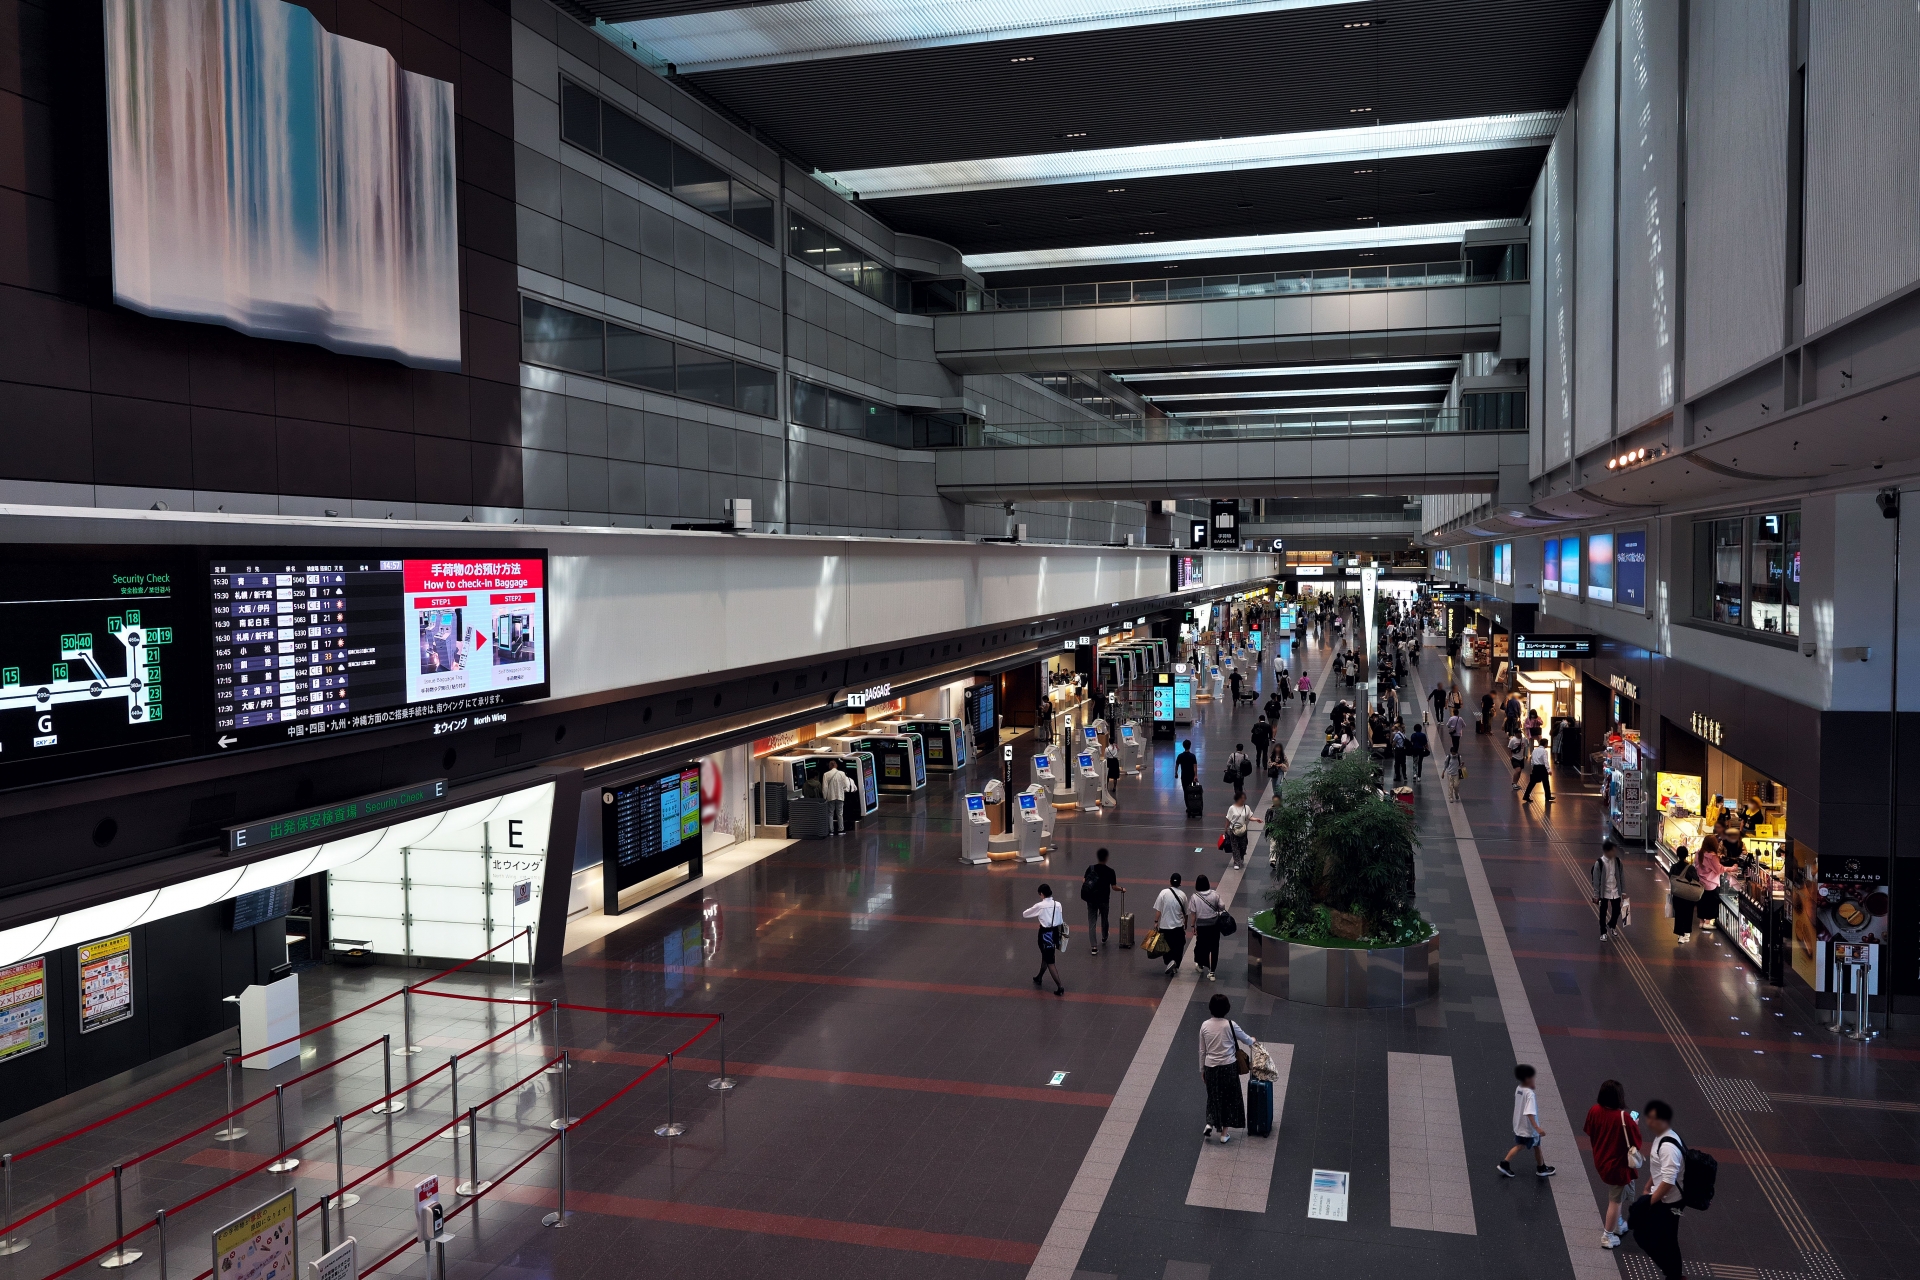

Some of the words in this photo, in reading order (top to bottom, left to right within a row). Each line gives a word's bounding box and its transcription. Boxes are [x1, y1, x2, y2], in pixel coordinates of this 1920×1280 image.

[1194, 526, 1204, 542] F
[1274, 539, 1282, 549] G
[383, 561, 400, 569] 14:57
[431, 564, 521, 577] 手荷物のお預け方法
[113, 574, 144, 585] Security
[147, 574, 170, 582] Check
[424, 580, 444, 589] How
[445, 580, 455, 588] to
[457, 579, 492, 588] check-in
[495, 578, 528, 589] Baggage
[128, 614, 139, 623] 18
[1186, 612, 1191, 621] F
[110, 621, 120, 630] 17
[147, 632, 158, 641] 20
[160, 631, 170, 640] 19
[63, 638, 75, 650] 30
[79, 636, 91, 648] 40
[148, 651, 158, 660] 21
[5, 671, 17, 682] 15
[55, 667, 66, 678] 16
[149, 670, 159, 680] 22
[1610, 674, 1624, 692] AIRPORT
[1626, 681, 1636, 699] DRUG
[150, 689, 160, 699] 23
[851, 695, 862, 705] 11
[865, 683, 890, 701] BAGGAGE
[150, 708, 160, 718] 24
[38, 715, 52, 732] G
[474, 715, 491, 726] North
[492, 713, 507, 722] Wing
[433, 718, 467, 734] 北ウイング
[435, 782, 443, 796] E
[270, 804, 357, 839] 出発保安検査場
[366, 798, 398, 813] Security
[401, 791, 424, 804] Check
[237, 829, 246, 847] E
[509, 820, 523, 848] E
[493, 860, 540, 871] 北ウイング
